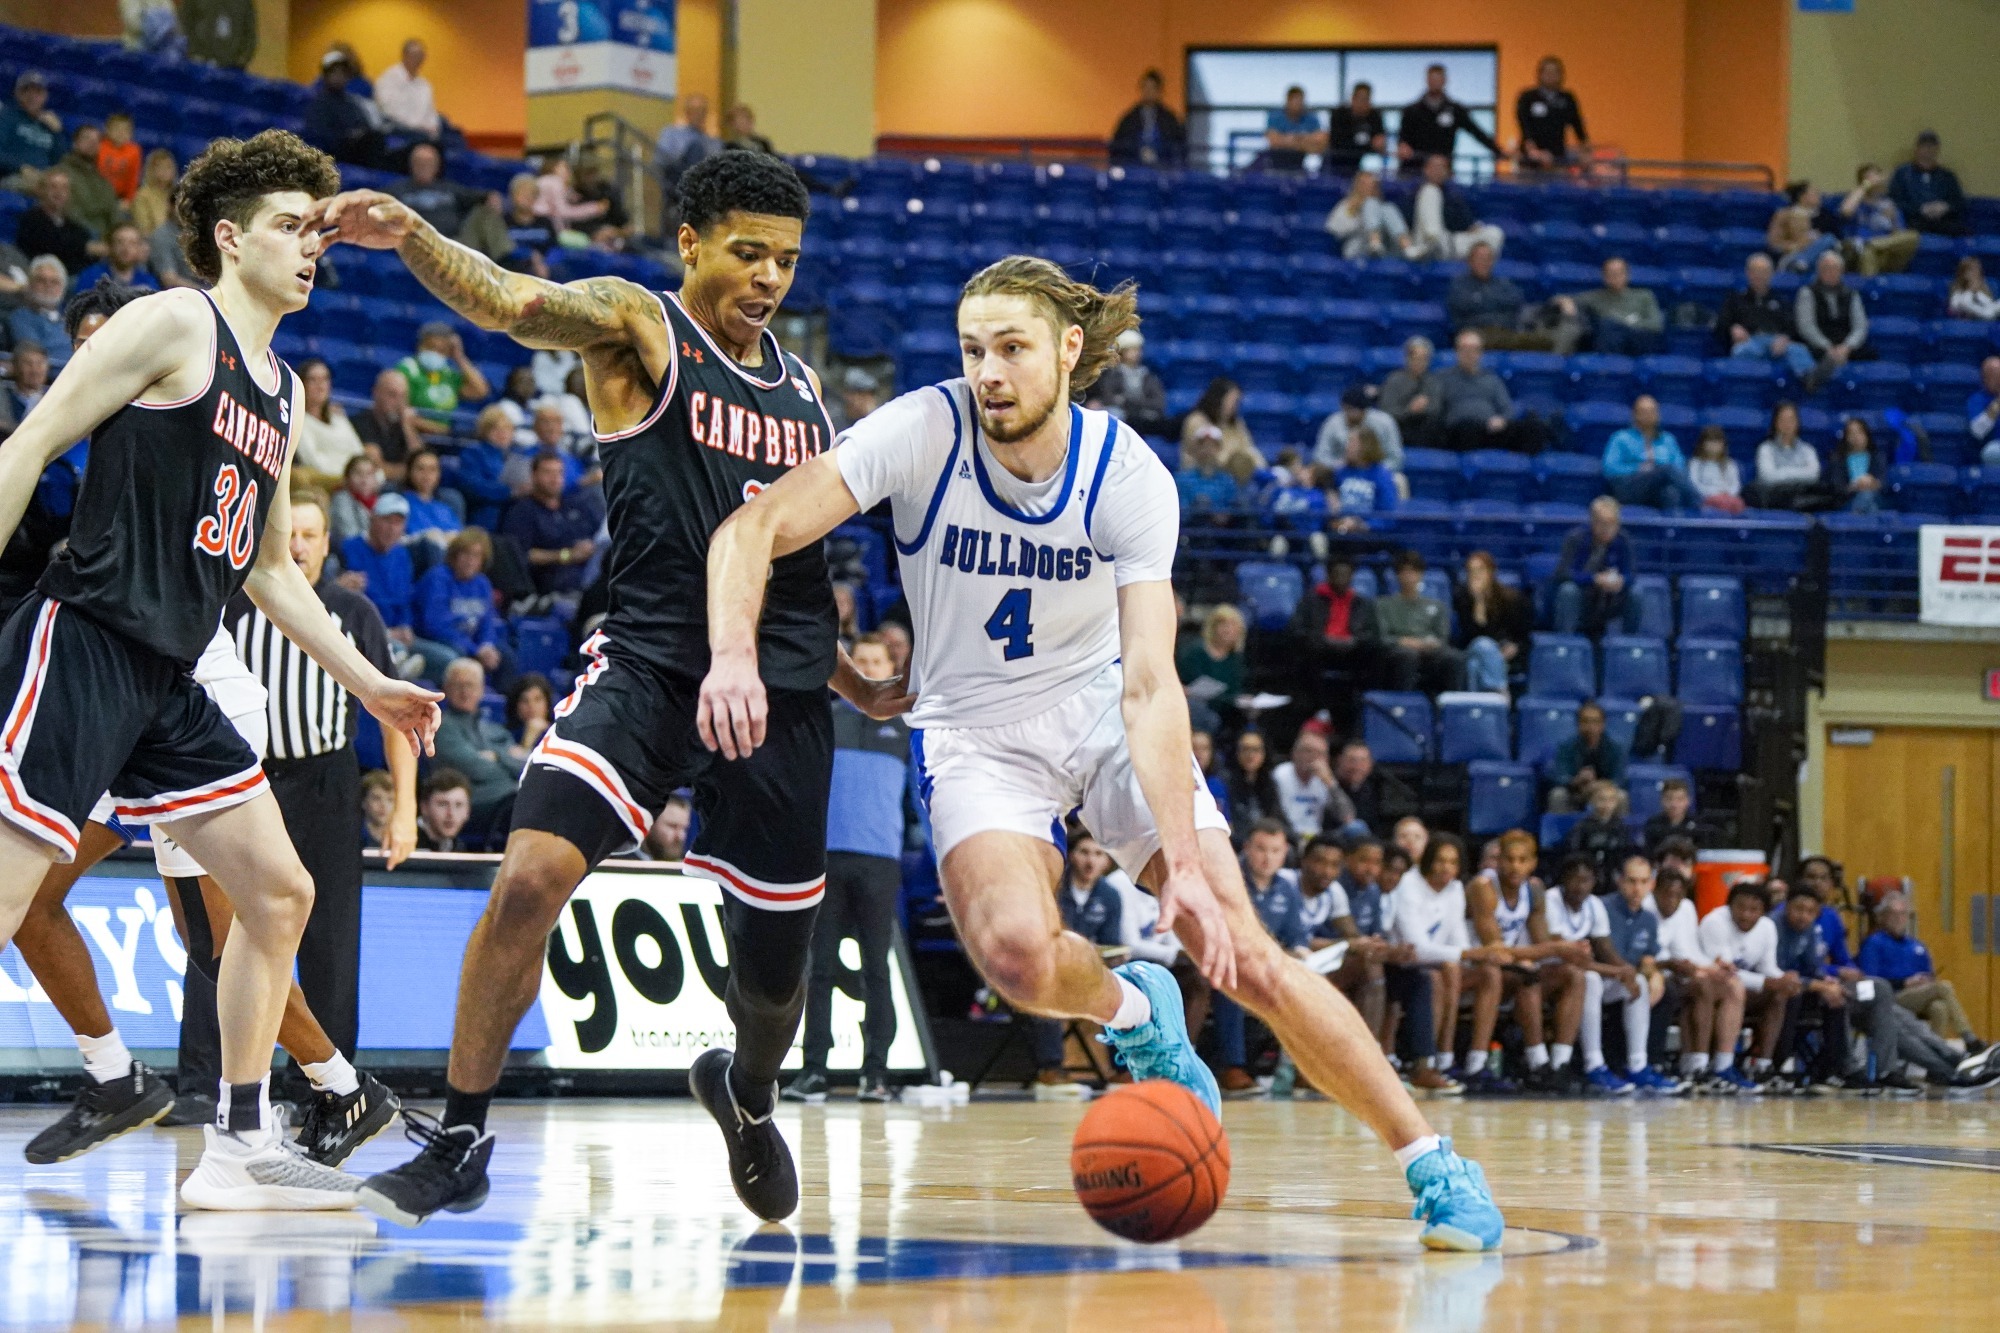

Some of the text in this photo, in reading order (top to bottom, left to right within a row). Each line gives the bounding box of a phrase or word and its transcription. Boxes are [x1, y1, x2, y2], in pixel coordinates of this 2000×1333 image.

[212, 390, 286, 481] CAMPBELL
[193, 463, 258, 570] 30
[939, 523, 1093, 582] BULLDOGS
[984, 588, 1034, 662] 4
